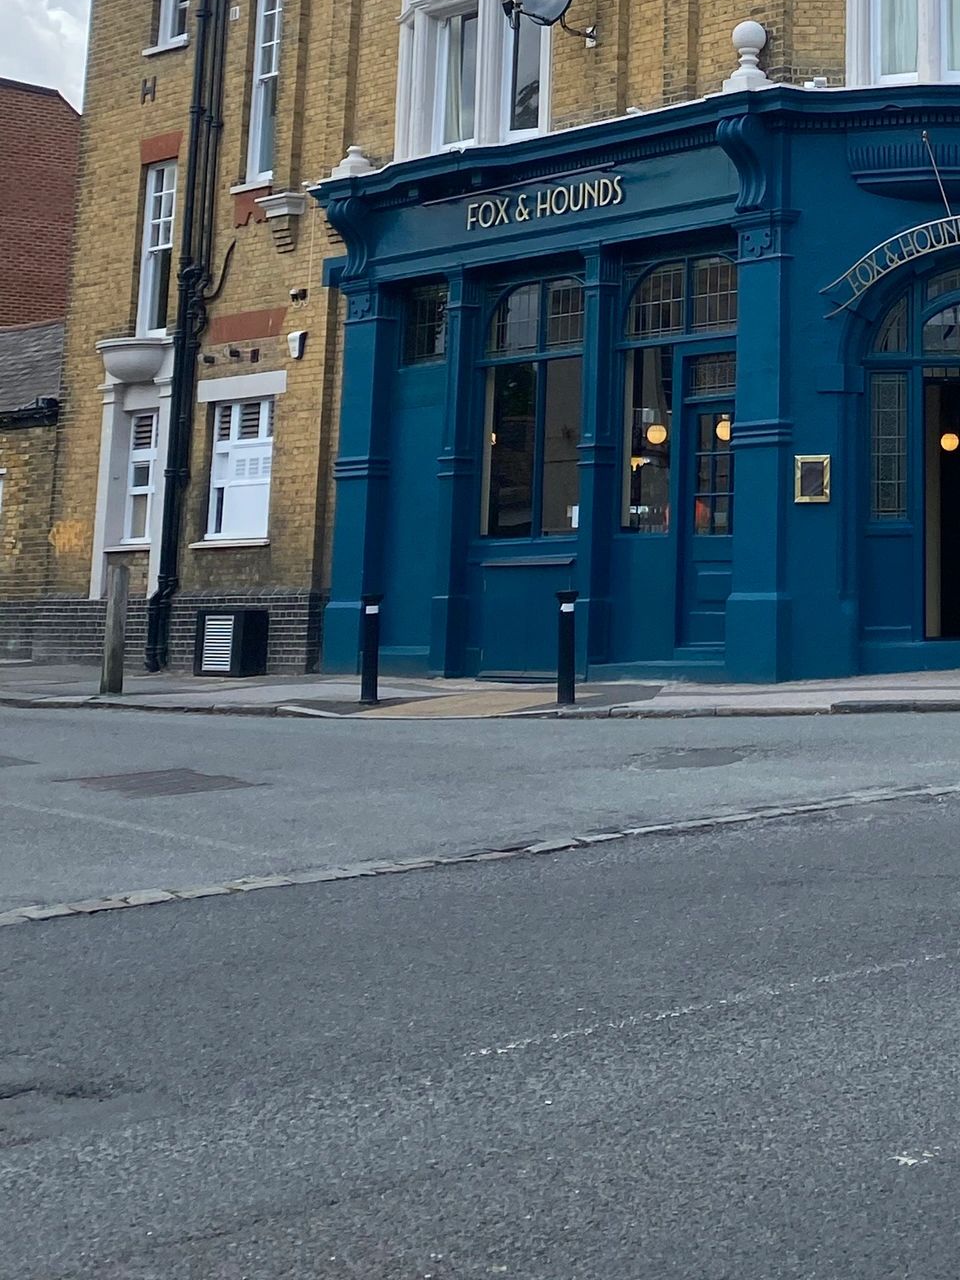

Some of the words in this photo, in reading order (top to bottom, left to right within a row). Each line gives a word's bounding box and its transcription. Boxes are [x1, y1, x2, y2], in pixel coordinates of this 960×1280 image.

[466, 197, 510, 231] FOX
[515, 194, 530, 222] &
[536, 175, 623, 218] HOUNDS
[846, 253, 885, 296] FOX
[884, 243, 900, 266] &
